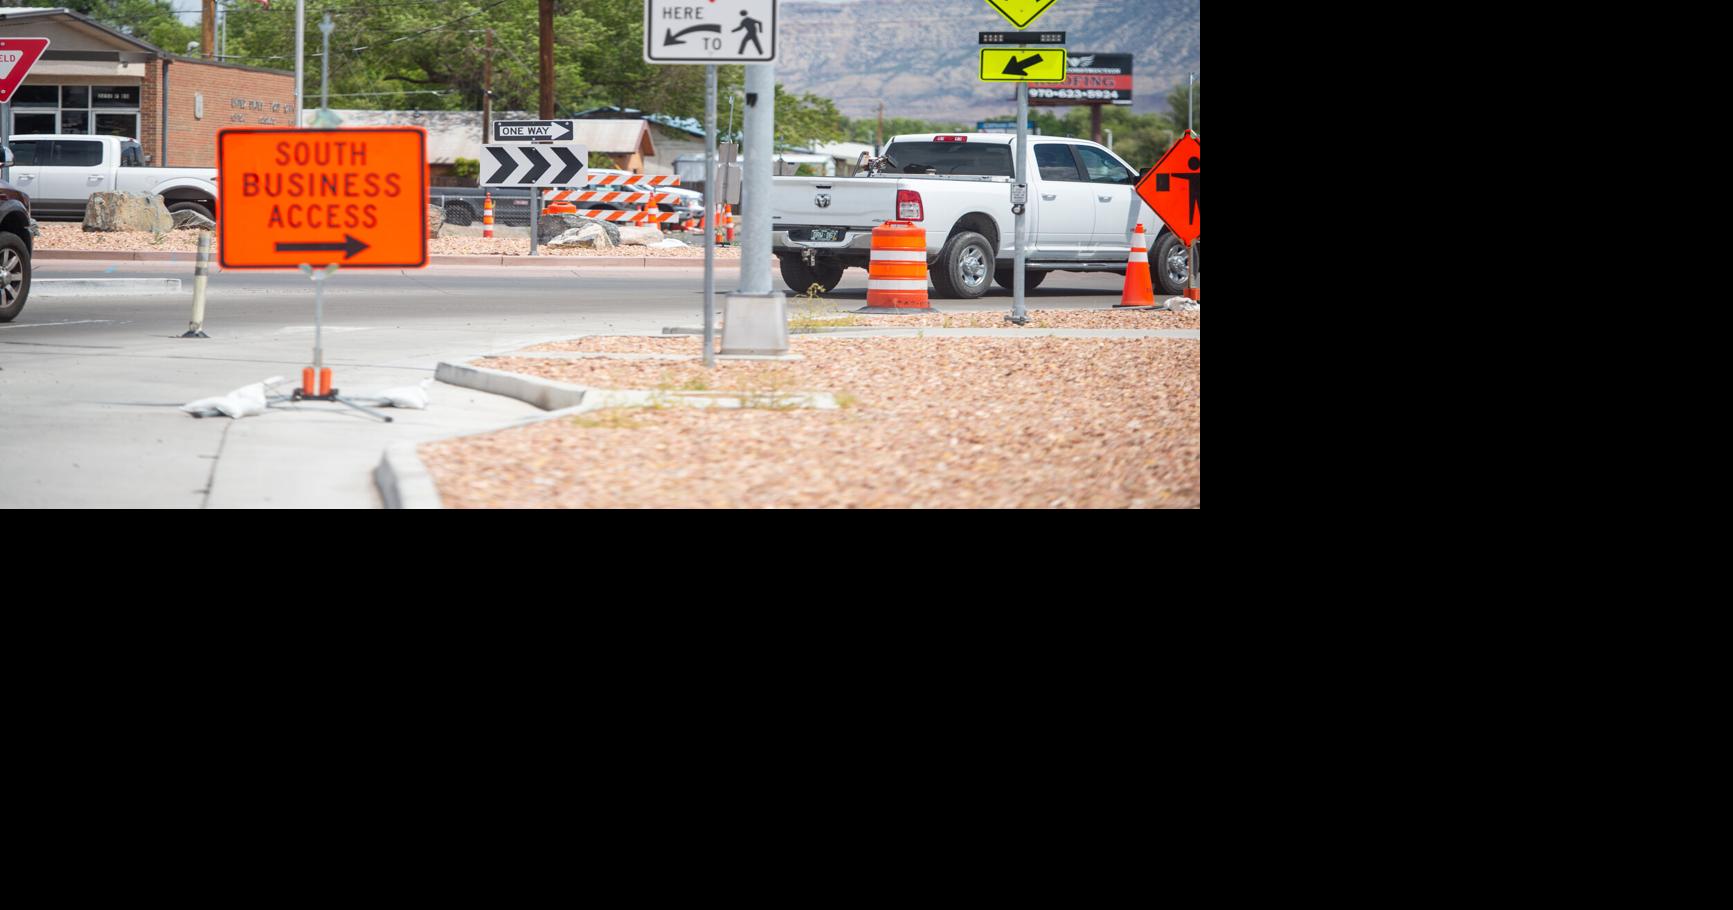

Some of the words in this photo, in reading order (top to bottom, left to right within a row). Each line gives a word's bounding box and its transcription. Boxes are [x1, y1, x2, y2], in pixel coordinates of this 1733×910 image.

[662, 6, 705, 20] HERE
[703, 37, 722, 50] TO
[502, 127, 524, 135] ONE
[527, 127, 549, 135] WAY
[275, 141, 367, 167] SOUTH
[242, 172, 402, 198] BUSINESS
[267, 204, 378, 229] ACCESS
